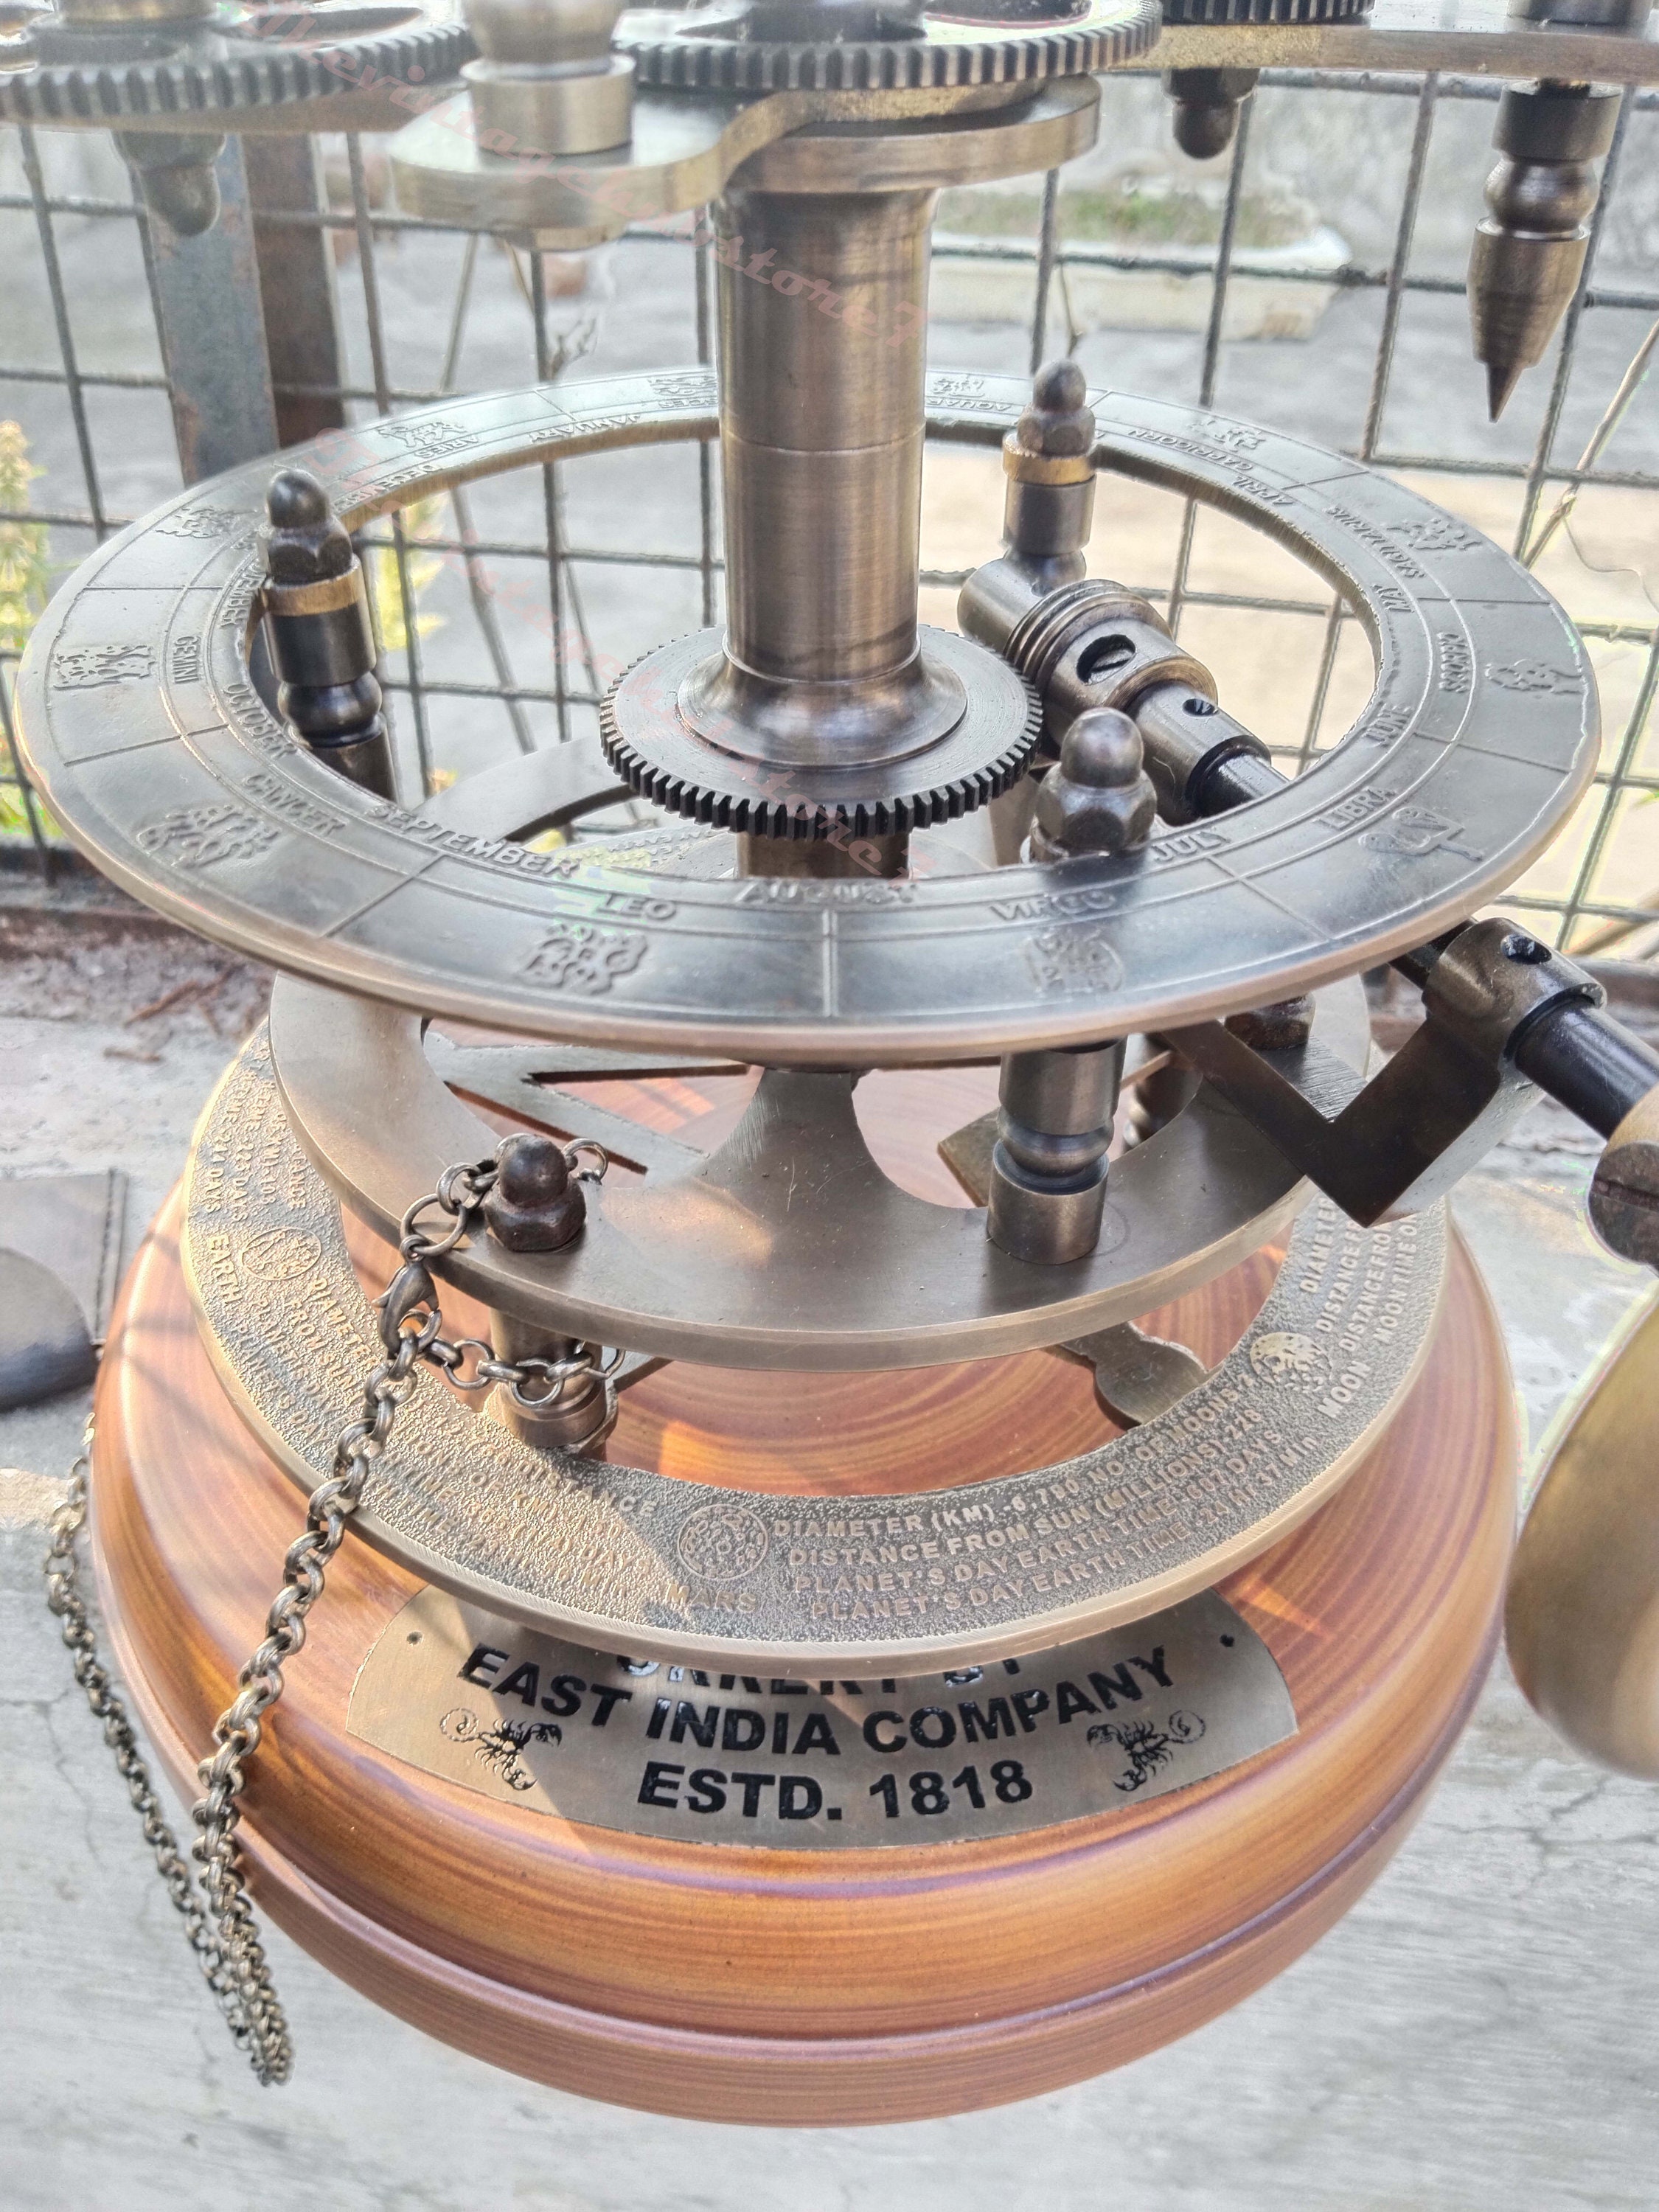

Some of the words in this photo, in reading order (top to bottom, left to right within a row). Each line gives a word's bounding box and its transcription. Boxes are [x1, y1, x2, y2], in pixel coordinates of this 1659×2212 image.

[414, 436, 479, 459] ARIES
[529, 414, 642, 442] JANUARY
[1127, 429, 1253, 471] CAPRICORN
[1231, 476, 1293, 507] APRIL
[1372, 583, 1415, 613] MAY
[174, 636, 203, 685] GEMINI
[223, 683, 297, 759] OCTOBER
[1366, 704, 1412, 743] JUNE
[1313, 787, 1398, 830] LIBRA
[367, 807, 582, 877] SEPTEMBER
[1151, 827, 1233, 862] JULY
[595, 893, 678, 921] LEO
[990, 890, 1116, 922] VIRGO
[206, 1166, 225, 1214] DAYS
[229, 1176, 251, 1222] DAYS
[207, 1234, 245, 1305] EARTH
[1390, 1241, 1419, 1283] TIME
[1312, 1247, 1361, 1333] DISTANCE
[1334, 1269, 1388, 1352] DISTANCE
[1368, 1287, 1413, 1345] MOON
[281, 1297, 327, 1353] FROM
[315, 1351, 357, 1392] SUN
[466, 1469, 506, 1498] OF
[310, 1276, 383, 1374] DIAMETER
[513, 1458, 658, 1518] DISTANCE
[1312, 1359, 1377, 1419] MOON
[774, 1514, 927, 1538] DIAMETER
[927, 1501, 999, 1533] (KM)
[1130, 1436, 1172, 1463] OF
[792, 1565, 948, 1593] PLANET'S
[950, 1554, 1016, 1582] DAY
[1014, 1525, 1115, 1569] EARTH
[1108, 1497, 1180, 1537] TIME
[1221, 1428, 1285, 1475] DAYS
[577, 1541, 654, 1577] DAYS
[790, 1540, 942, 1566] DISTANCE
[943, 1521, 1032, 1556] FROM
[1030, 1503, 1095, 1536] SUN
[810, 1589, 966, 1619] PLANET'S
[965, 1577, 1028, 1606] DAY
[1029, 1547, 1130, 1593] EARTH
[1125, 1520, 1194, 1559] TIME
[1223, 1480, 1262, 1506] Hr
[1250, 1461, 1288, 1488] 37
[667, 1582, 758, 1615] MARS
[457, 1643, 633, 1727] EAST
[646, 1697, 841, 1756] INDIA
[863, 1645, 1174, 1753] COMPANY
[637, 1761, 843, 1821] ESTD.
[869, 1759, 1033, 1819] 1818
